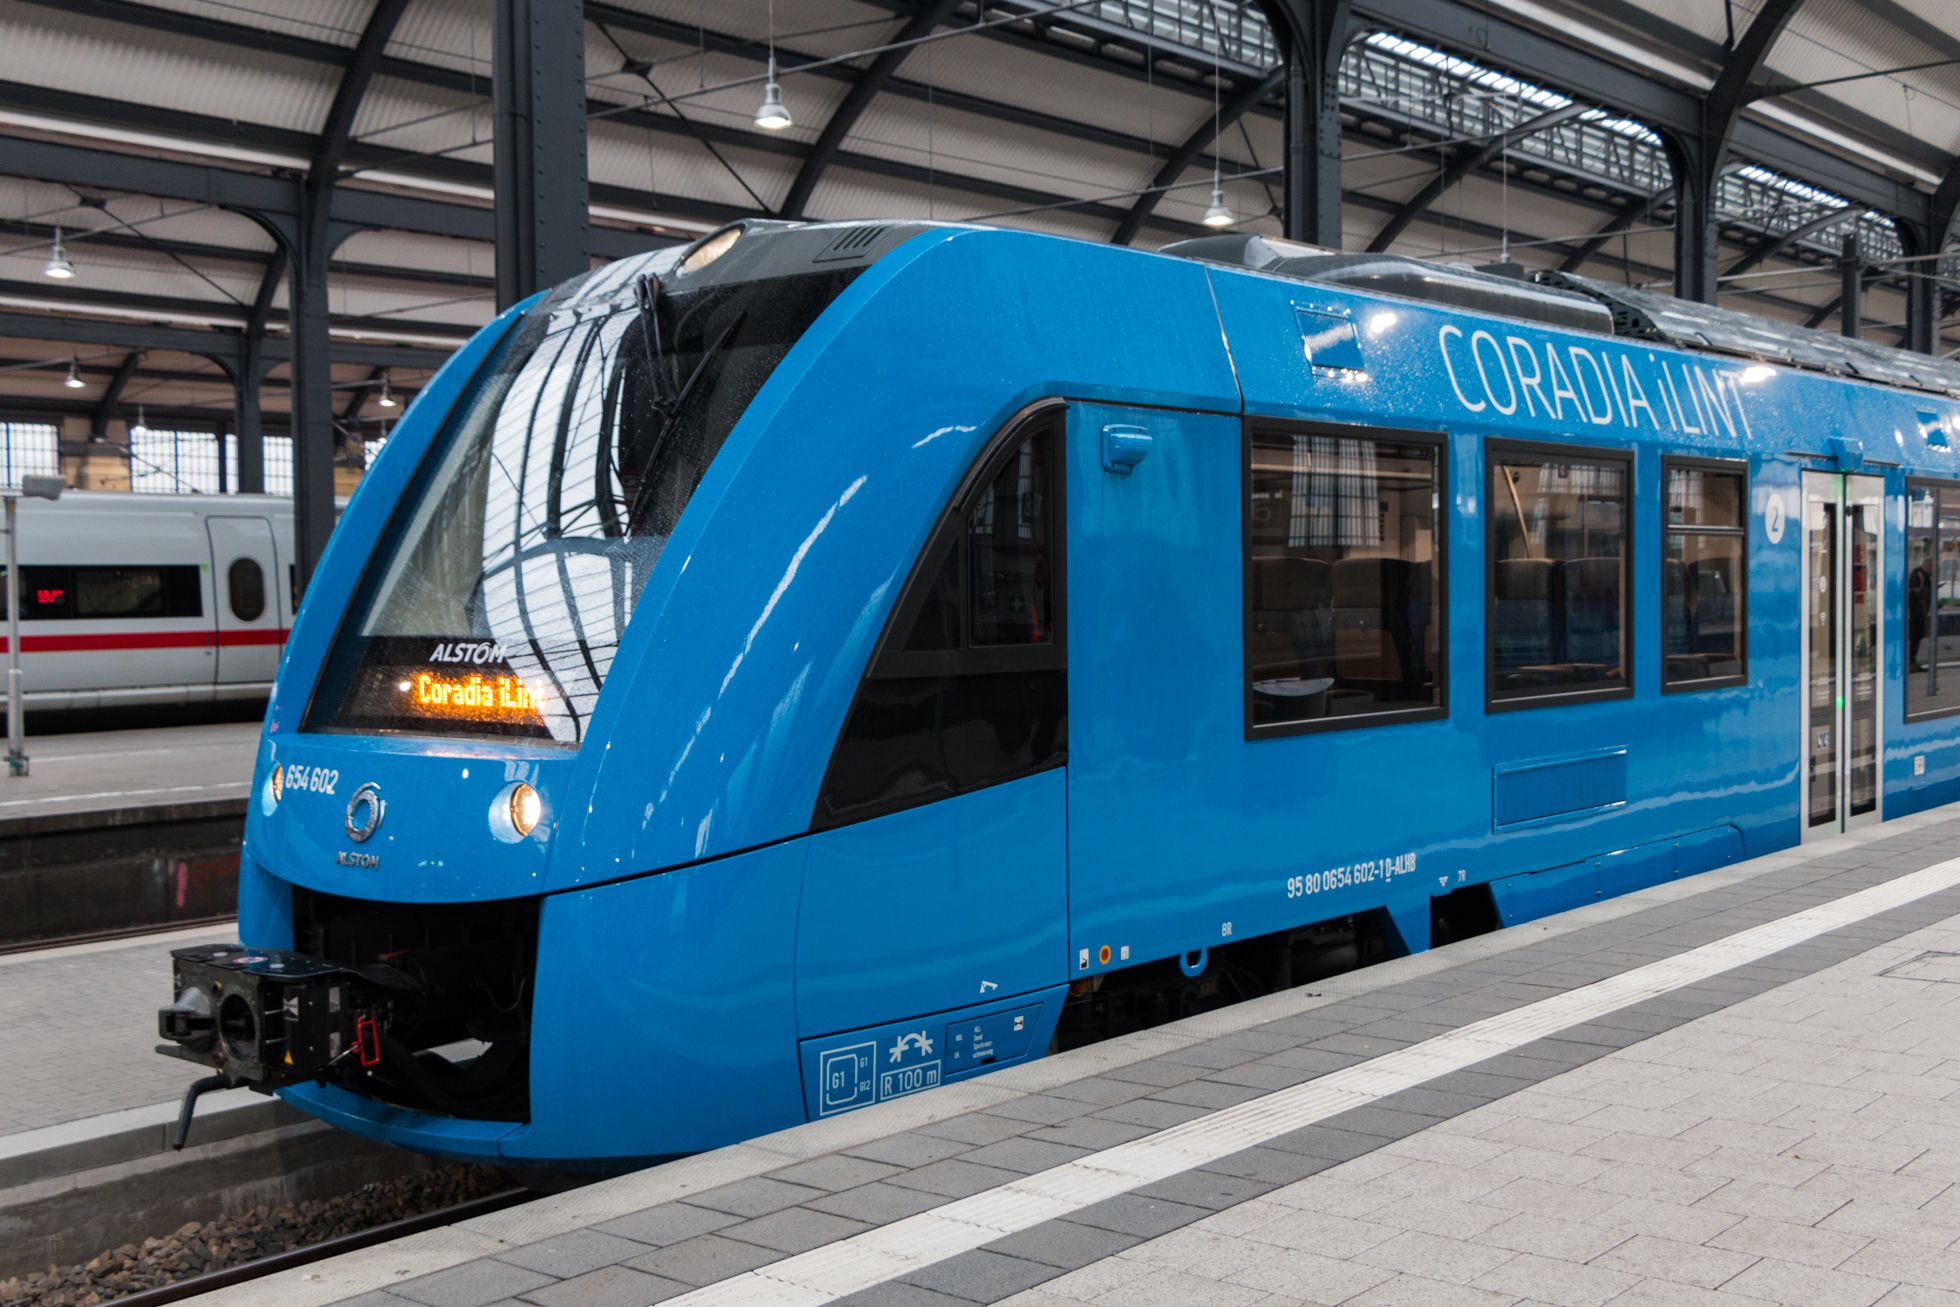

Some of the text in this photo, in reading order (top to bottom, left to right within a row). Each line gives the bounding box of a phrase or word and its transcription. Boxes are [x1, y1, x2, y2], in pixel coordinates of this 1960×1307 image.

[1439, 324, 1660, 431] CORADIA
[1771, 506, 1779, 532] 2
[429, 641, 508, 665] ALSTOM
[418, 674, 494, 707] Coradia
[285, 764, 339, 795] 654 602
[336, 850, 380, 870] ALSTOM
[1287, 852, 1417, 899] 95 80 0654 602-1 D-ALHB
[1221, 921, 1232, 937] 8R
[860, 1056, 868, 1068] G1
[832, 1070, 845, 1089] G1
[884, 1068, 937, 1096] R 100 m
